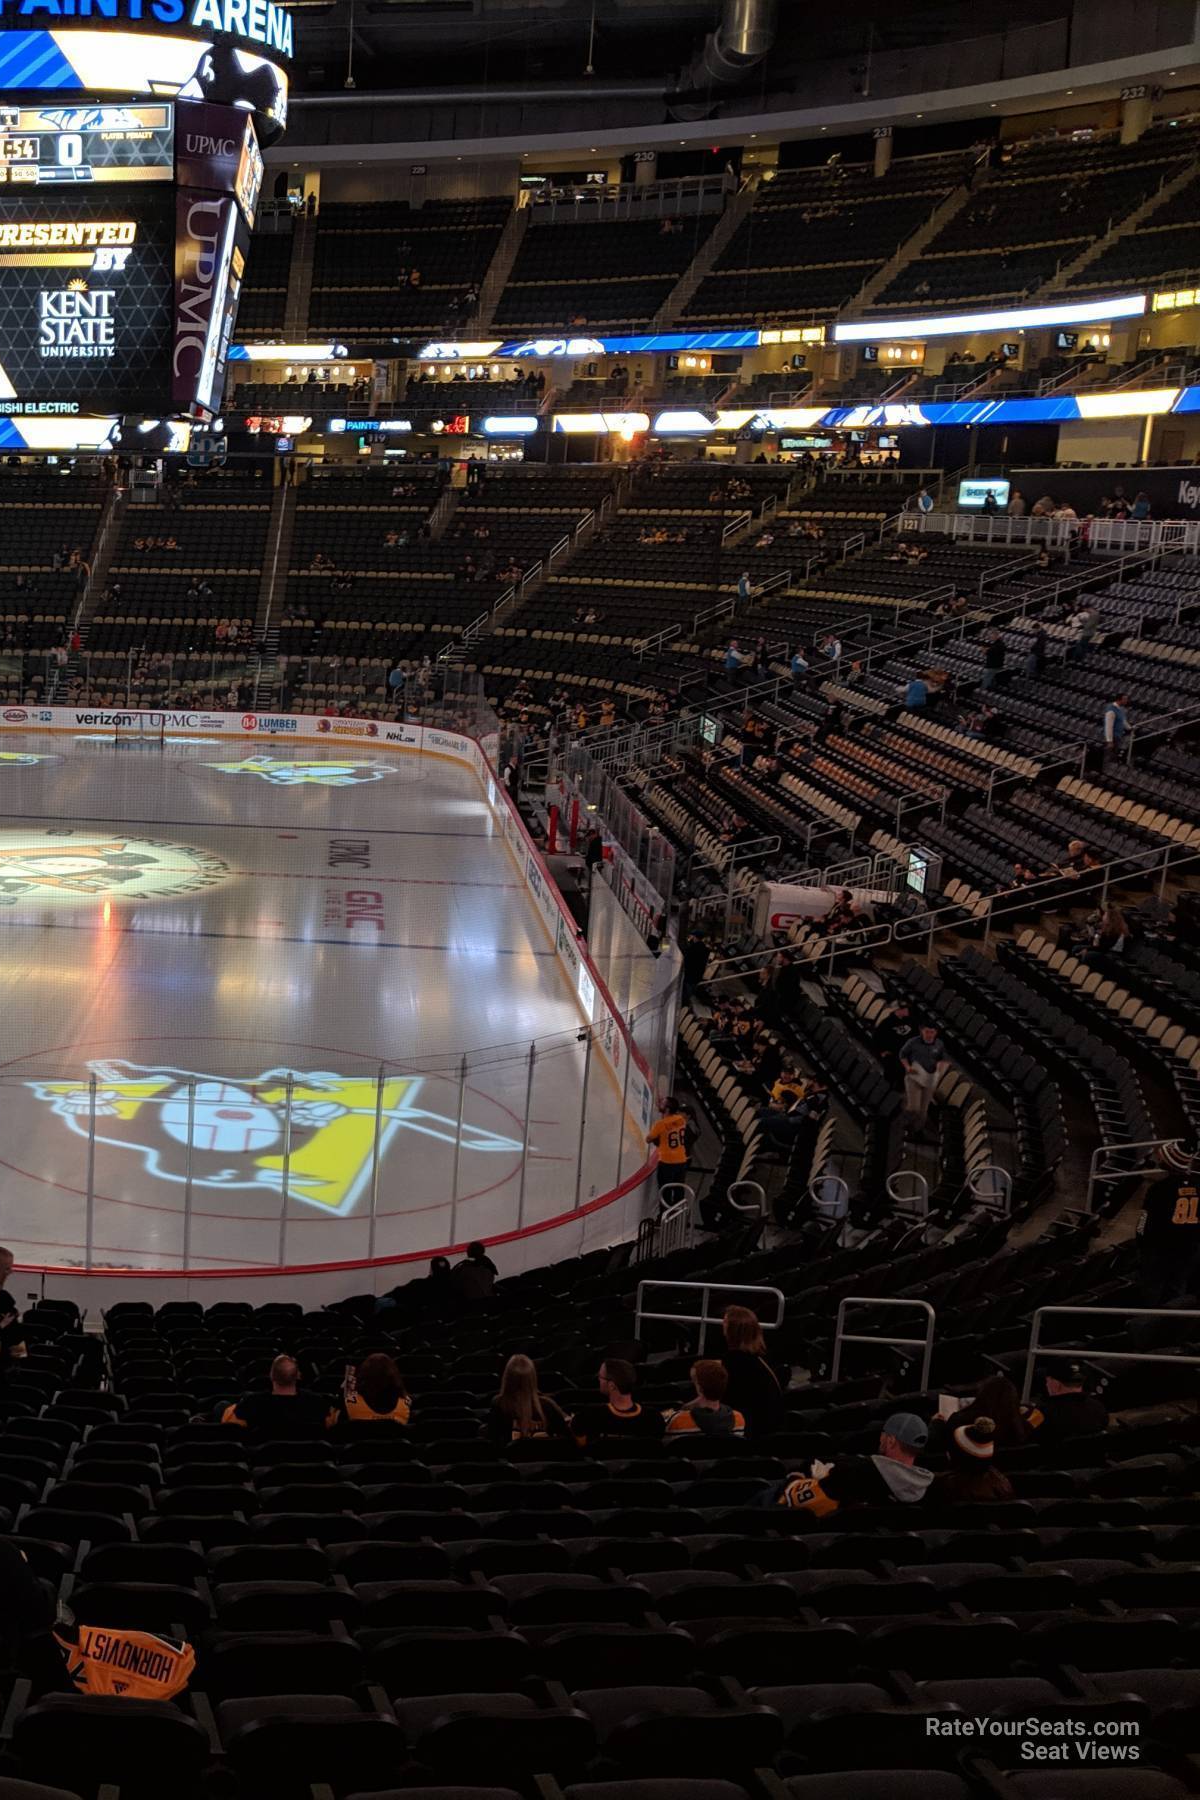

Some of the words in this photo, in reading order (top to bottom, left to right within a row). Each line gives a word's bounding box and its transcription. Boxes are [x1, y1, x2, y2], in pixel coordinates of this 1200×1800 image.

[192, 0, 293, 58] ARENA
[1121, 86, 1145, 100] 232
[126, 132, 153, 140] PENALTY
[873, 127, 891, 139] 231
[58, 134, 82, 166] 0
[186, 133, 235, 157] UPMC
[634, 151, 654, 162] 230
[93, 247, 132, 271] BY
[173, 198, 224, 378] UPMC
[40, 290, 116, 317] KENT
[40, 317, 115, 345] STATE
[25, 402, 79, 413] ELECTRIC
[347, 421, 379, 430] PAINTS
[903, 519, 918, 529] 121
[76, 712, 131, 726] verizon
[150, 714, 198, 728] UPMC
[259, 719, 297, 728] LUMBER
[328, 838, 371, 869] UPMC
[345, 890, 385, 931] GNC
